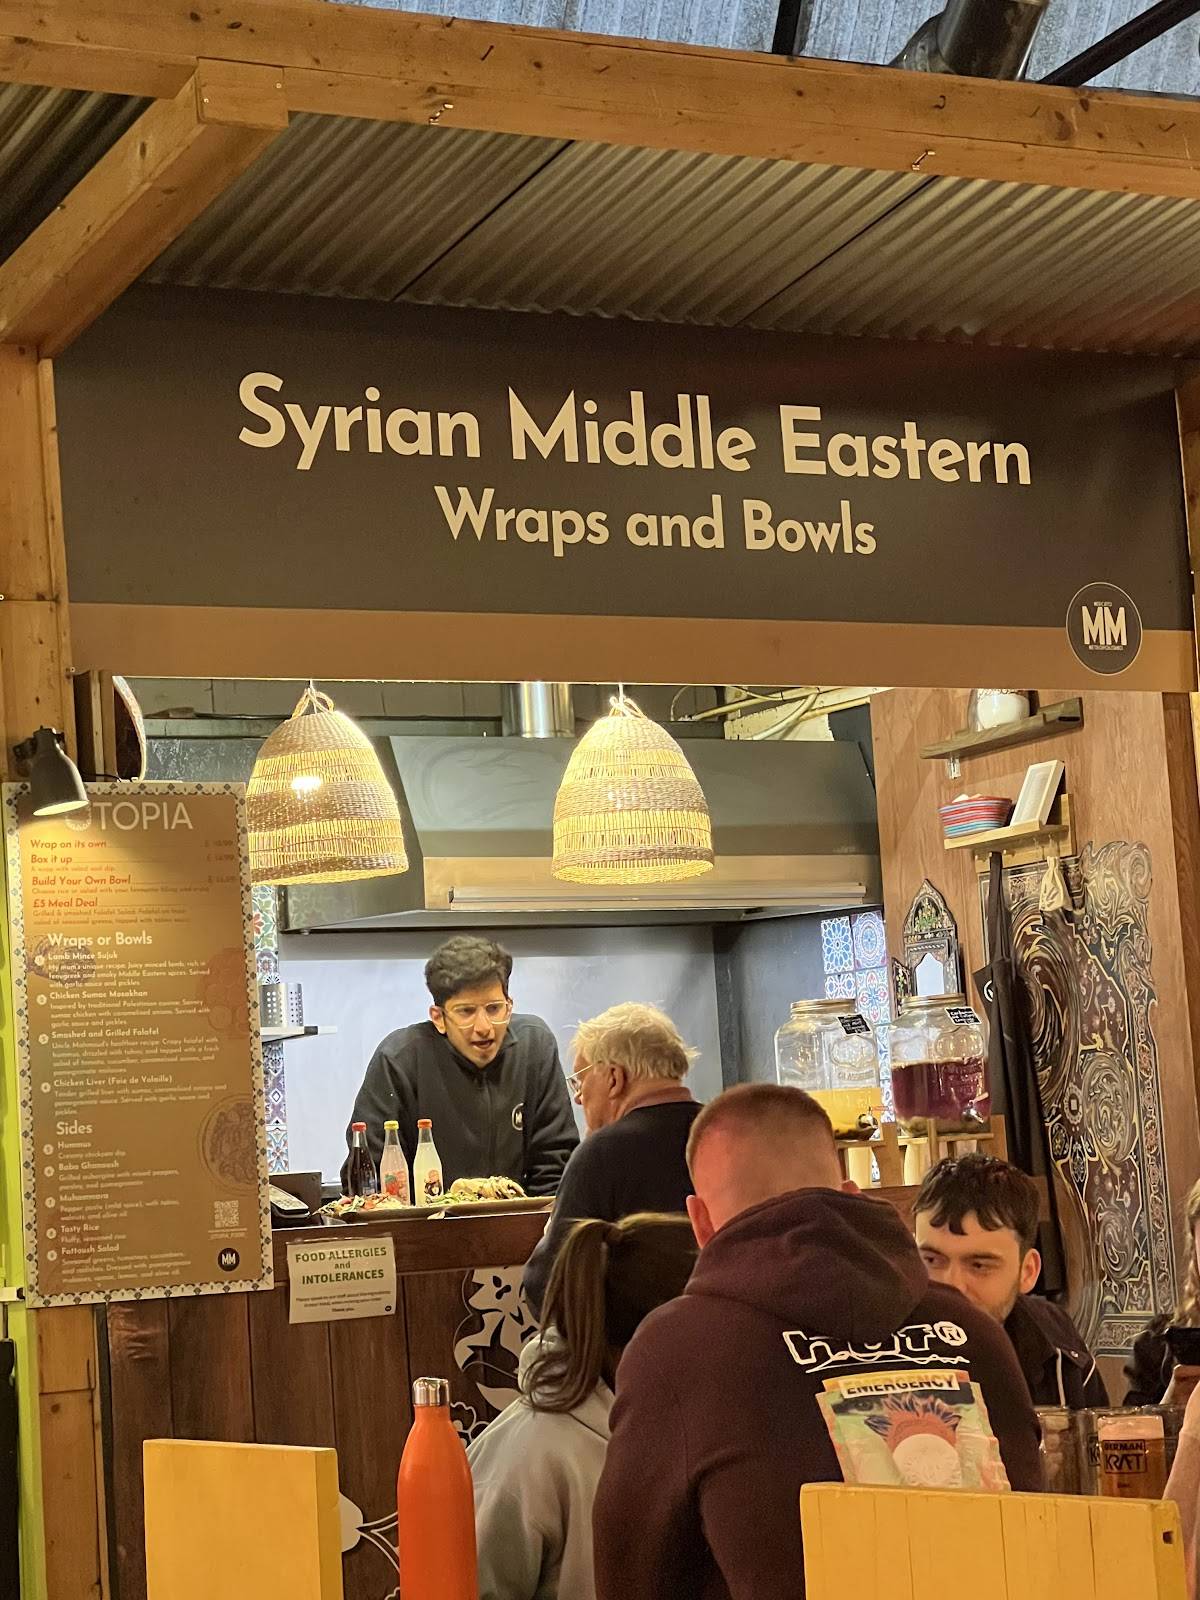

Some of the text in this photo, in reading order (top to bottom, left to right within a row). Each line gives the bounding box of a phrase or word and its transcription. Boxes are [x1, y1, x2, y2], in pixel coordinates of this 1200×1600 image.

[238, 372, 1031, 485] Syrian Middle Eastern
[434, 485, 877, 557] Wraps and Bowls
[1081, 606, 1128, 646] MM
[30, 839, 106, 851] Wrap on its own
[31, 854, 73, 865] Box it up
[32, 874, 131, 886] Build Your Own Bowl
[48, 897, 73, 908] Meal
[76, 896, 98, 908] Deal
[48, 929, 153, 949] Wraps or Bowls
[48, 950, 118, 961] Lamb Mince Sujuk
[50, 990, 80, 1000] Chicken
[82, 990, 106, 999] Sumac
[52, 1026, 160, 1039] Smashed and Grilled Falafel
[54, 1078, 84, 1088] Chicken
[86, 1078, 106, 1086] Liver
[129, 1076, 139, 1084] de
[56, 1119, 94, 1136] Sides
[61, 1224, 100, 1234] Tasty Rice
[62, 1244, 120, 1255] Fattoush Salad
[295, 1246, 387, 1263] FOOD ALLERGIES
[334, 1261, 351, 1270] and
[302, 1269, 385, 1285] INTOLERANCES
[1105, 1453, 1144, 1471] KRAFT
